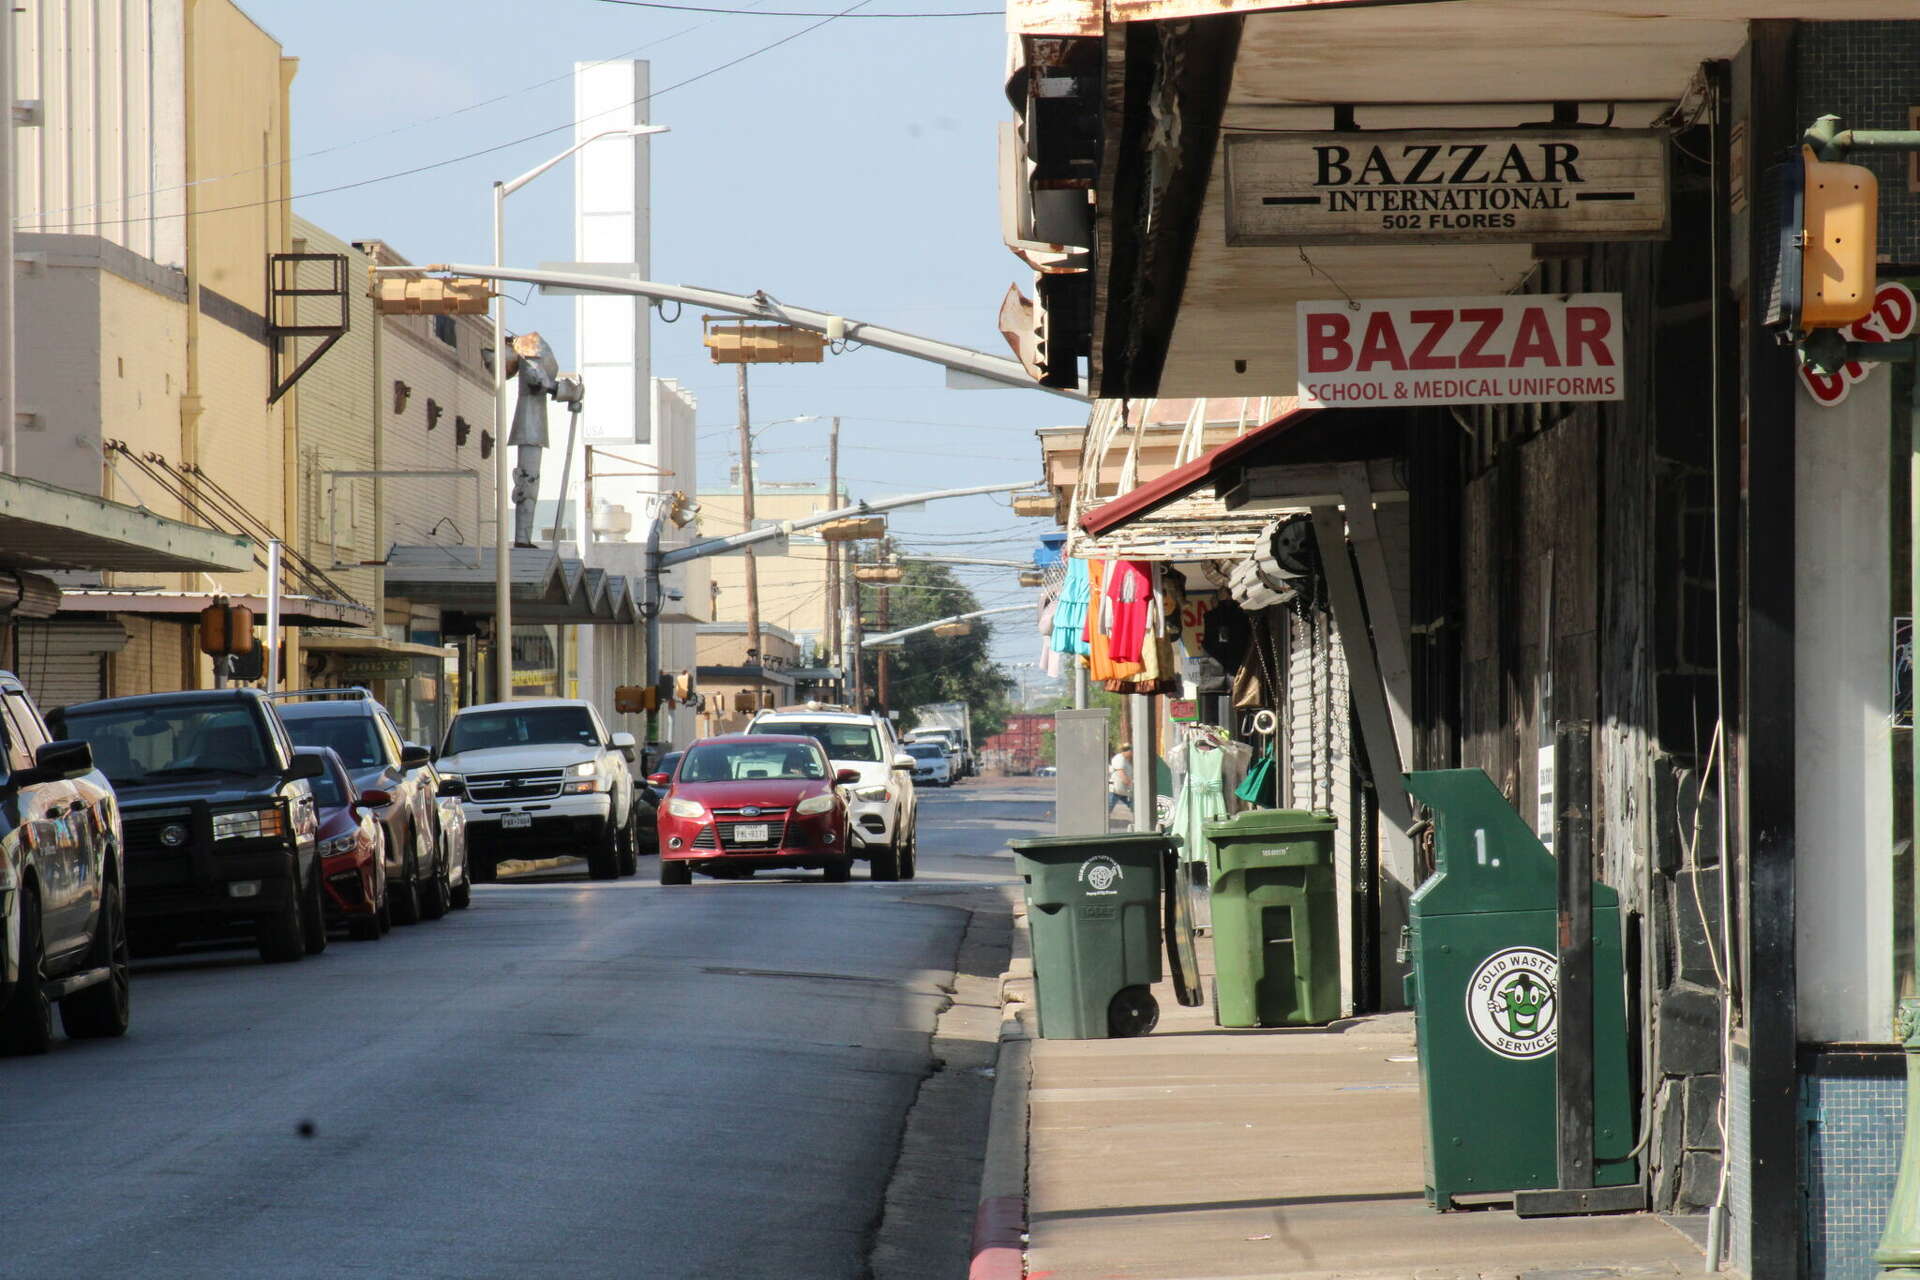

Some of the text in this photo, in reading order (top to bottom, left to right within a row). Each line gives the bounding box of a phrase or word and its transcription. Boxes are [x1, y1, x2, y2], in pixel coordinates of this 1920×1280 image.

[1312, 143, 1585, 186] BAZZAR
[1327, 188, 1570, 212] INTERNATIONAL
[1382, 213, 1516, 230] 502 FLORES
[1306, 306, 1615, 373] BAZZAR
[1307, 376, 1616, 402] SCHOOL & MEDICAL UNIFORMS
[1478, 956, 1554, 992] SOLID WASTE
[1496, 1029, 1558, 1052] SERVICES
